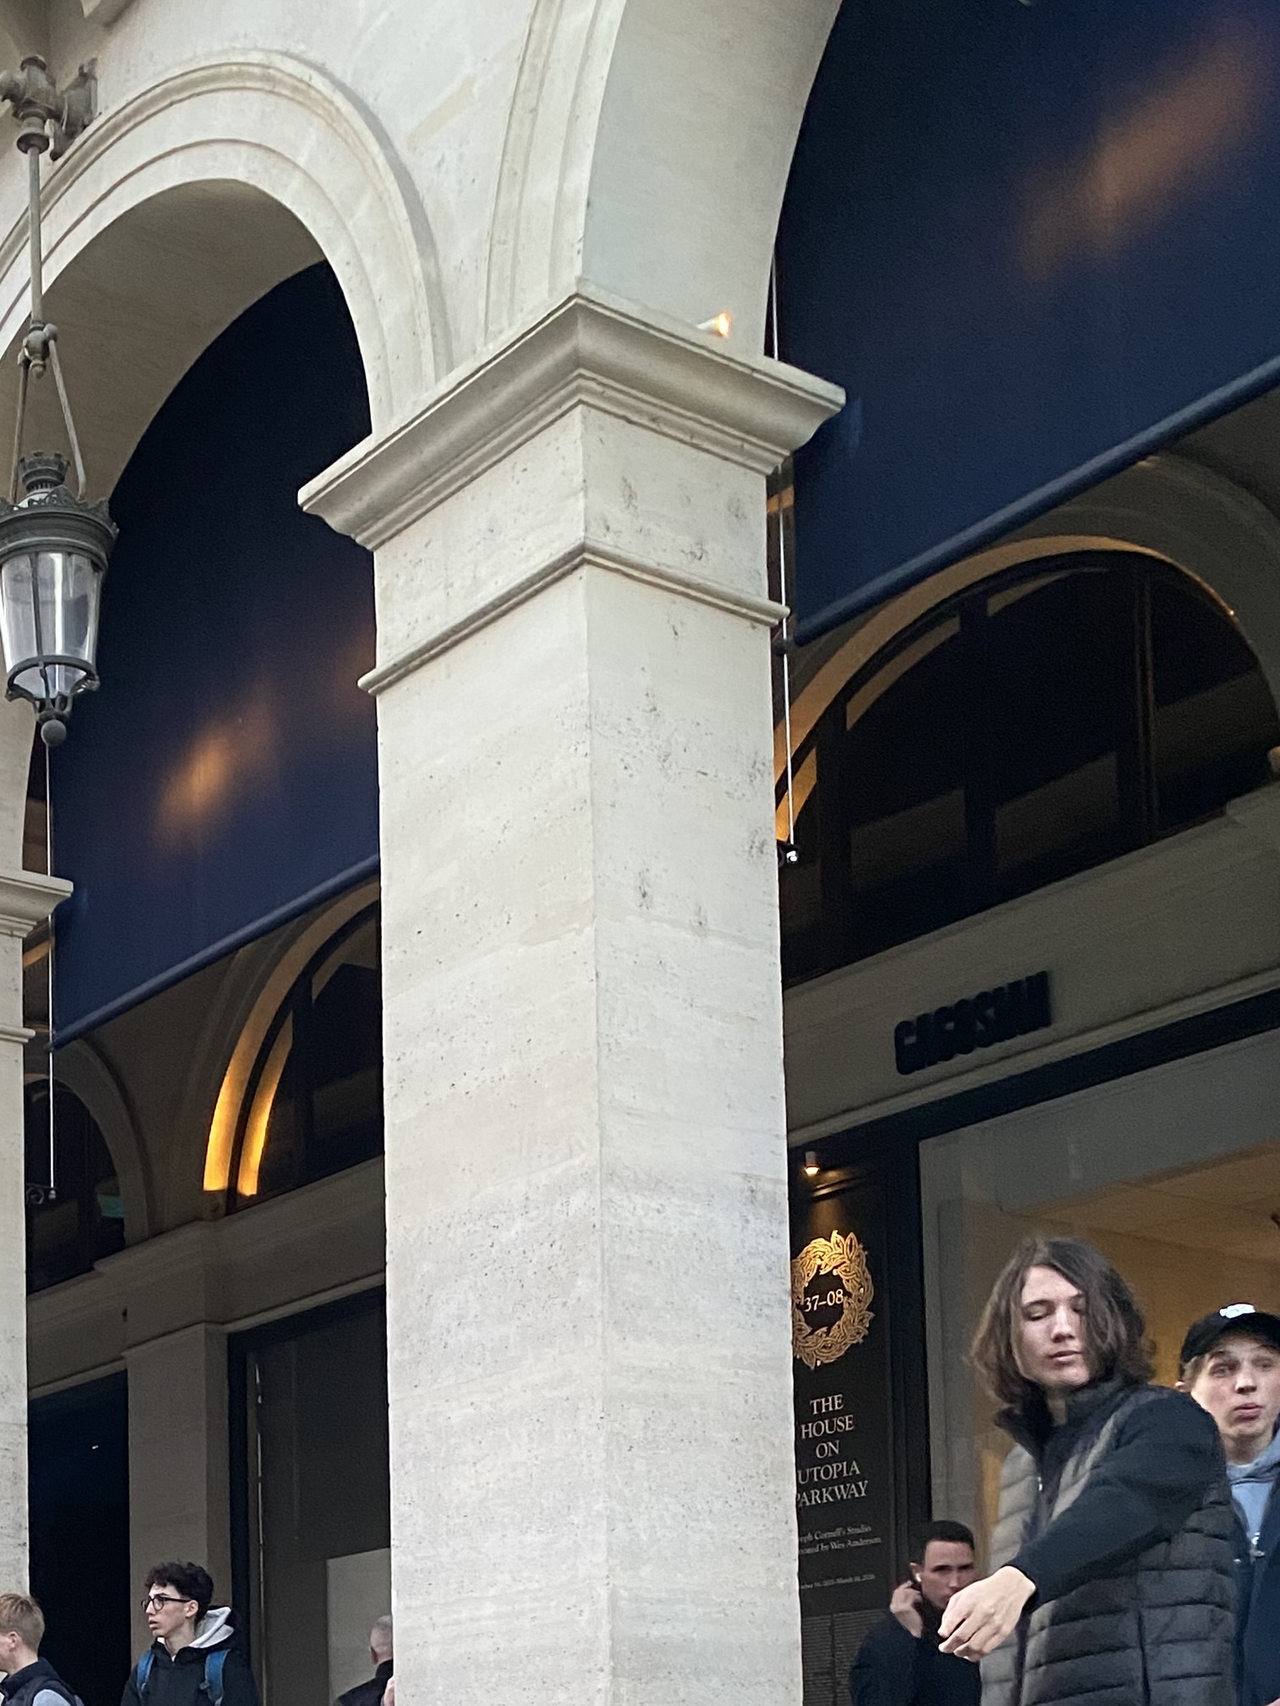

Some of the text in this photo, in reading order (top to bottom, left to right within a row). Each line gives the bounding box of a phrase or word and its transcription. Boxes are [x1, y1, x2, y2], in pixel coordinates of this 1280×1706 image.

[809, 1394, 844, 1415] THE
[801, 1415, 855, 1439] HOUSE
[816, 1440, 840, 1458] ON
[798, 1460, 860, 1484] UTOPIA
